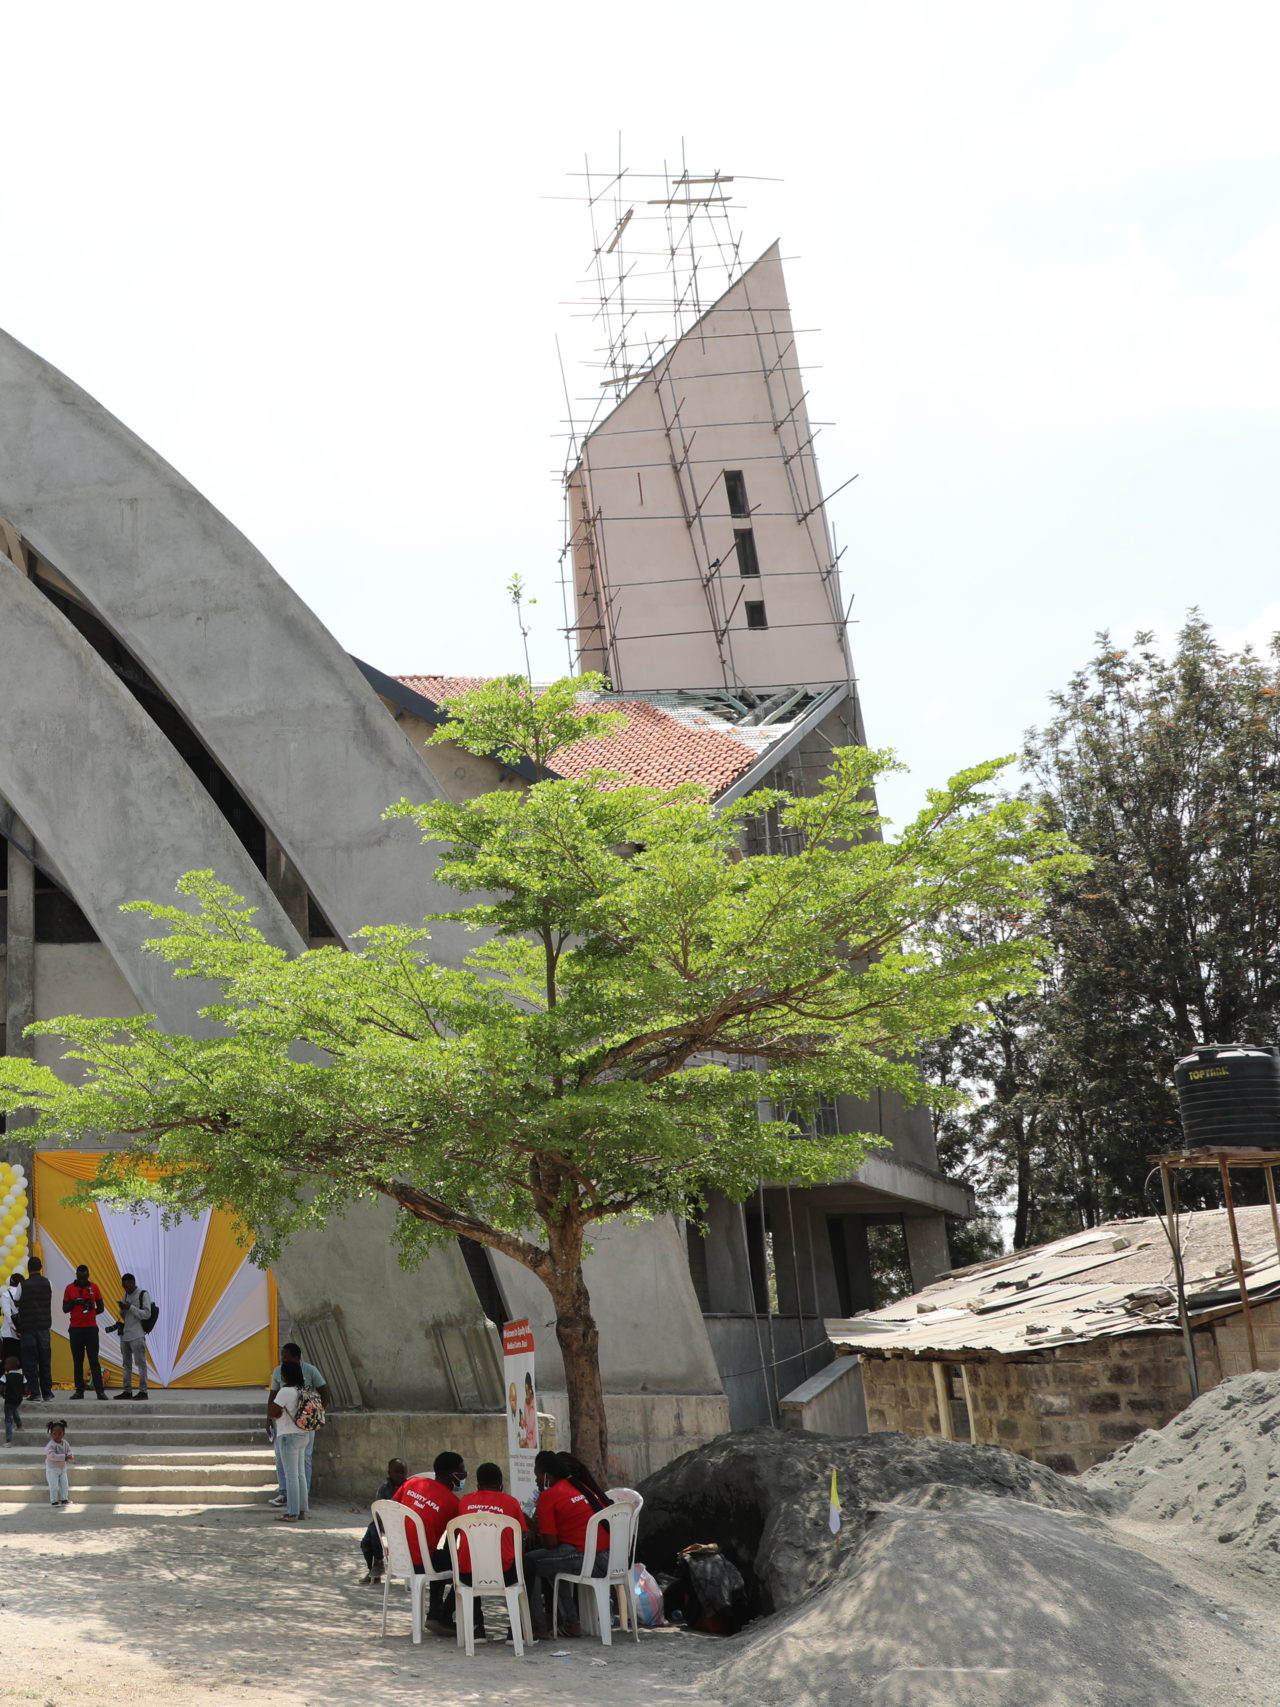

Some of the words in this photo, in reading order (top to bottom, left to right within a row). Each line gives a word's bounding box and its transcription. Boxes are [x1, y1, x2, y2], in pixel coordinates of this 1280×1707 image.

[407, 1490, 426, 1502] EQUITY
[425, 1500, 440, 1512] AFIA
[489, 1505, 504, 1513] AFIA
